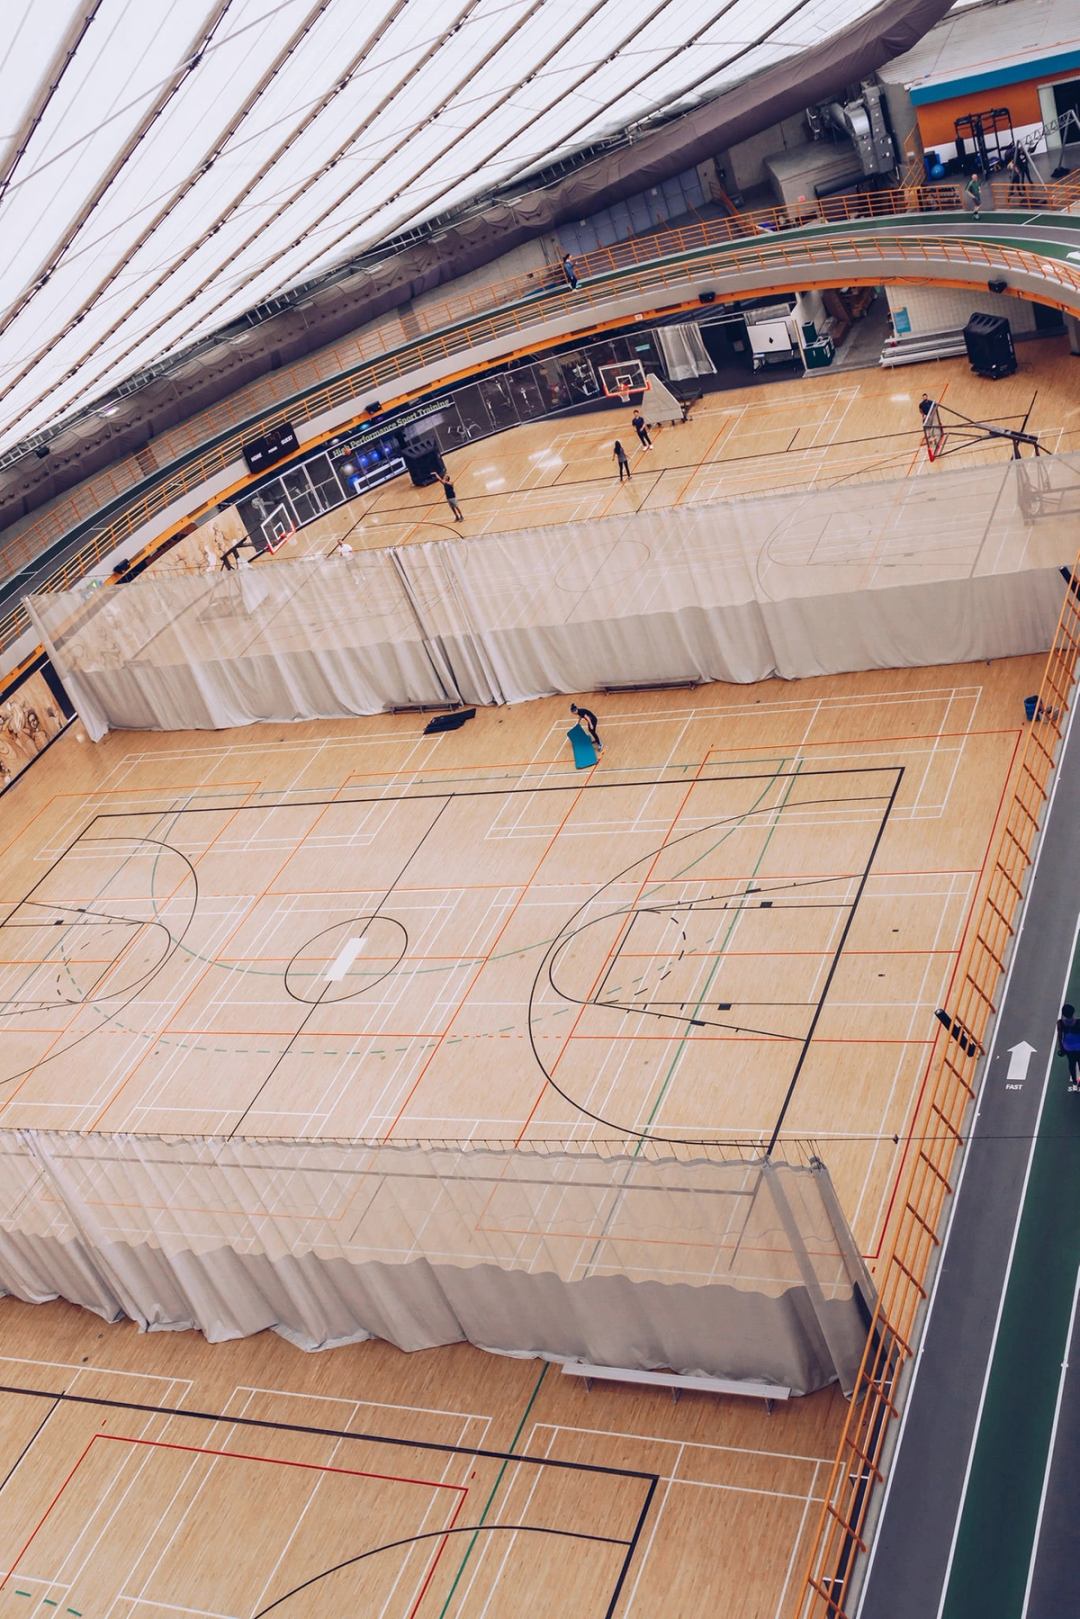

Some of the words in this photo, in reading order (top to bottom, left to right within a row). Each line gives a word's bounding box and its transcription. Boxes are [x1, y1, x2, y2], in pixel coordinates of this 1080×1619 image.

[350, 422, 396, 447] Performance
[396, 412, 416, 426] Sport
[416, 399, 449, 416] Training
